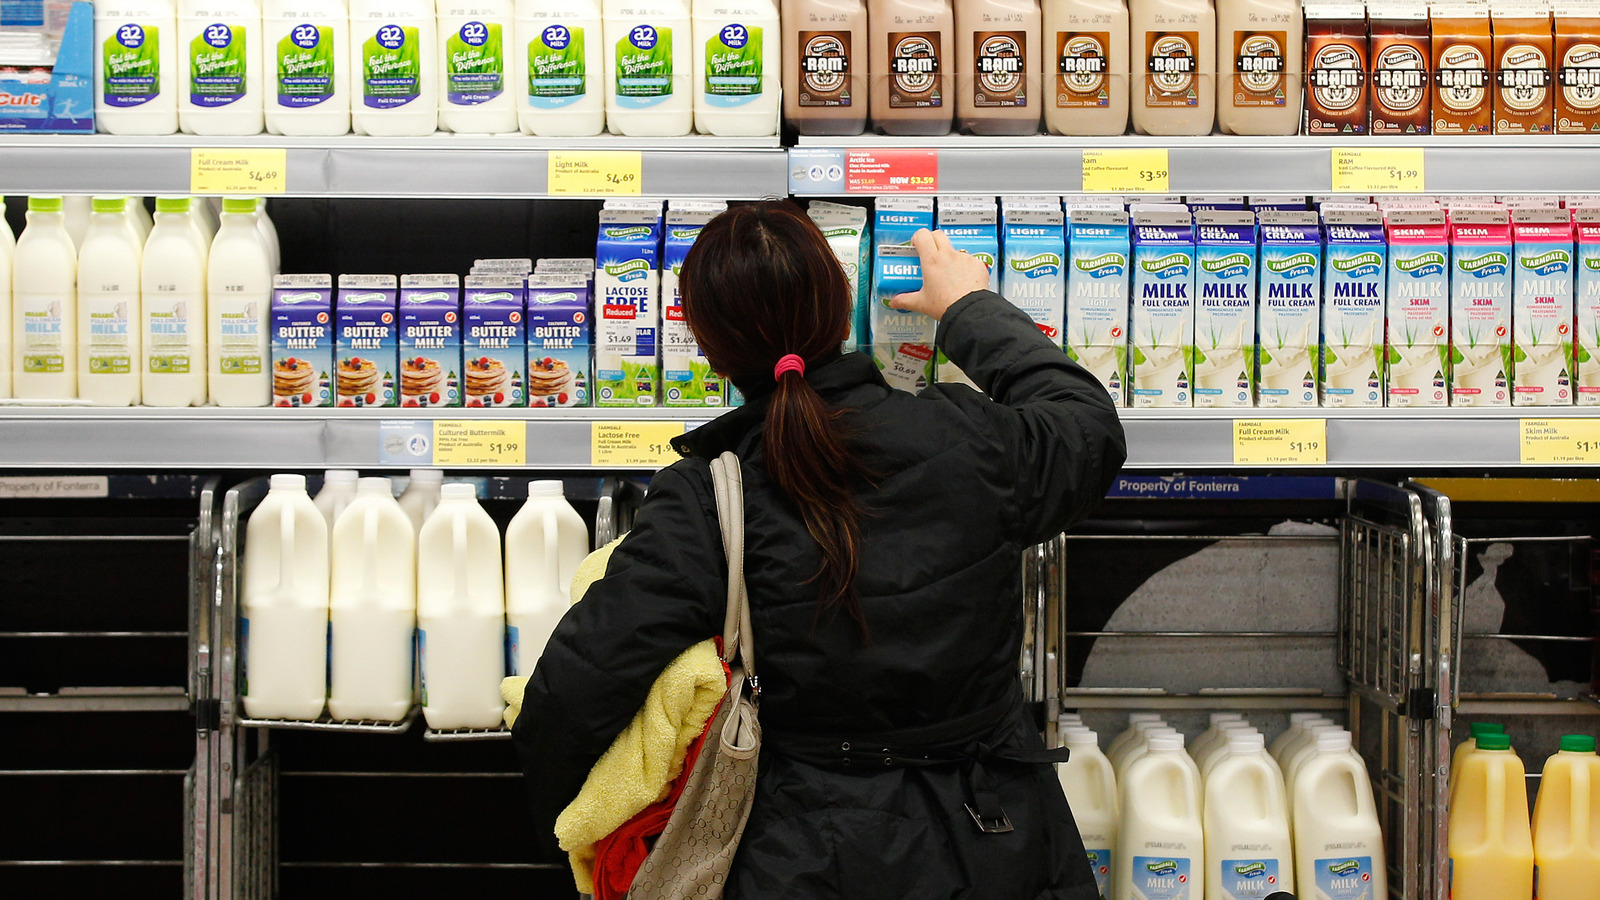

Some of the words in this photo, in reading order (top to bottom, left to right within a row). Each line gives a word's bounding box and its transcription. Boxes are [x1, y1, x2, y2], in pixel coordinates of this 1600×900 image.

[121, 25, 141, 39] a2
[208, 25, 228, 39] a2
[296, 26, 316, 40] a2
[381, 27, 401, 41] a2
[465, 24, 484, 38] a2
[547, 27, 567, 41] a2
[634, 27, 654, 41] a2
[724, 26, 744, 40] a2
[108, 55, 122, 65] Feel
[124, 53, 137, 62] the
[807, 58, 843, 71] RAM
[112, 58, 152, 74] Difference
[1317, 71, 1357, 85] RAM
[1380, 71, 1421, 85] RAM
[1441, 71, 1482, 85] RAM
[1503, 71, 1544, 86] RAM
[249, 171, 277, 181] $4.69
[607, 174, 634, 184] $4.69
[1140, 171, 1167, 181] $3.59
[1390, 170, 1417, 180] $1.99
[1016, 256, 1054, 269] FARMDALE
[1081, 256, 1119, 269] FARMDALE
[1147, 256, 1184, 269] FARMDALE
[1207, 255, 1245, 269] FARMDALE
[1272, 255, 1310, 269] FARMDALE
[883, 265, 918, 275] LIGHT
[1033, 268, 1052, 276] fresh
[1098, 268, 1117, 276] fresh
[1164, 268, 1183, 277] fresh
[606, 287, 648, 295] LACTOSE
[1012, 283, 1056, 298] MILK
[1077, 283, 1121, 298] MILK
[1143, 283, 1187, 298] MILK
[1203, 283, 1247, 298] MILK
[1269, 283, 1313, 298] MILK
[1398, 282, 1442, 297] MILK
[1460, 282, 1504, 297] MILK
[606, 308, 633, 316] Reduced
[280, 327, 324, 338] BUTTER
[344, 327, 389, 338] BUTTER
[407, 326, 452, 338] BUTTER
[471, 326, 516, 338] BUTTER
[535, 326, 580, 338] BUTTER
[287, 338, 317, 349] MILK
[351, 338, 381, 349] MILK
[415, 337, 445, 349] MILK
[479, 337, 509, 349] MILK
[543, 337, 573, 349] MILK
[608, 335, 631, 343] $1.49
[903, 345, 929, 357] Reduced
[490, 443, 517, 454] $1.99
[1290, 442, 1318, 452] $1.19
[0, 482, 40, 492] Property
[44, 482, 54, 490] of
[56, 482, 99, 490] Fonterra
[1120, 480, 1170, 493] Property
[1173, 481, 1186, 491] of
[1189, 481, 1239, 492] Fonterra
